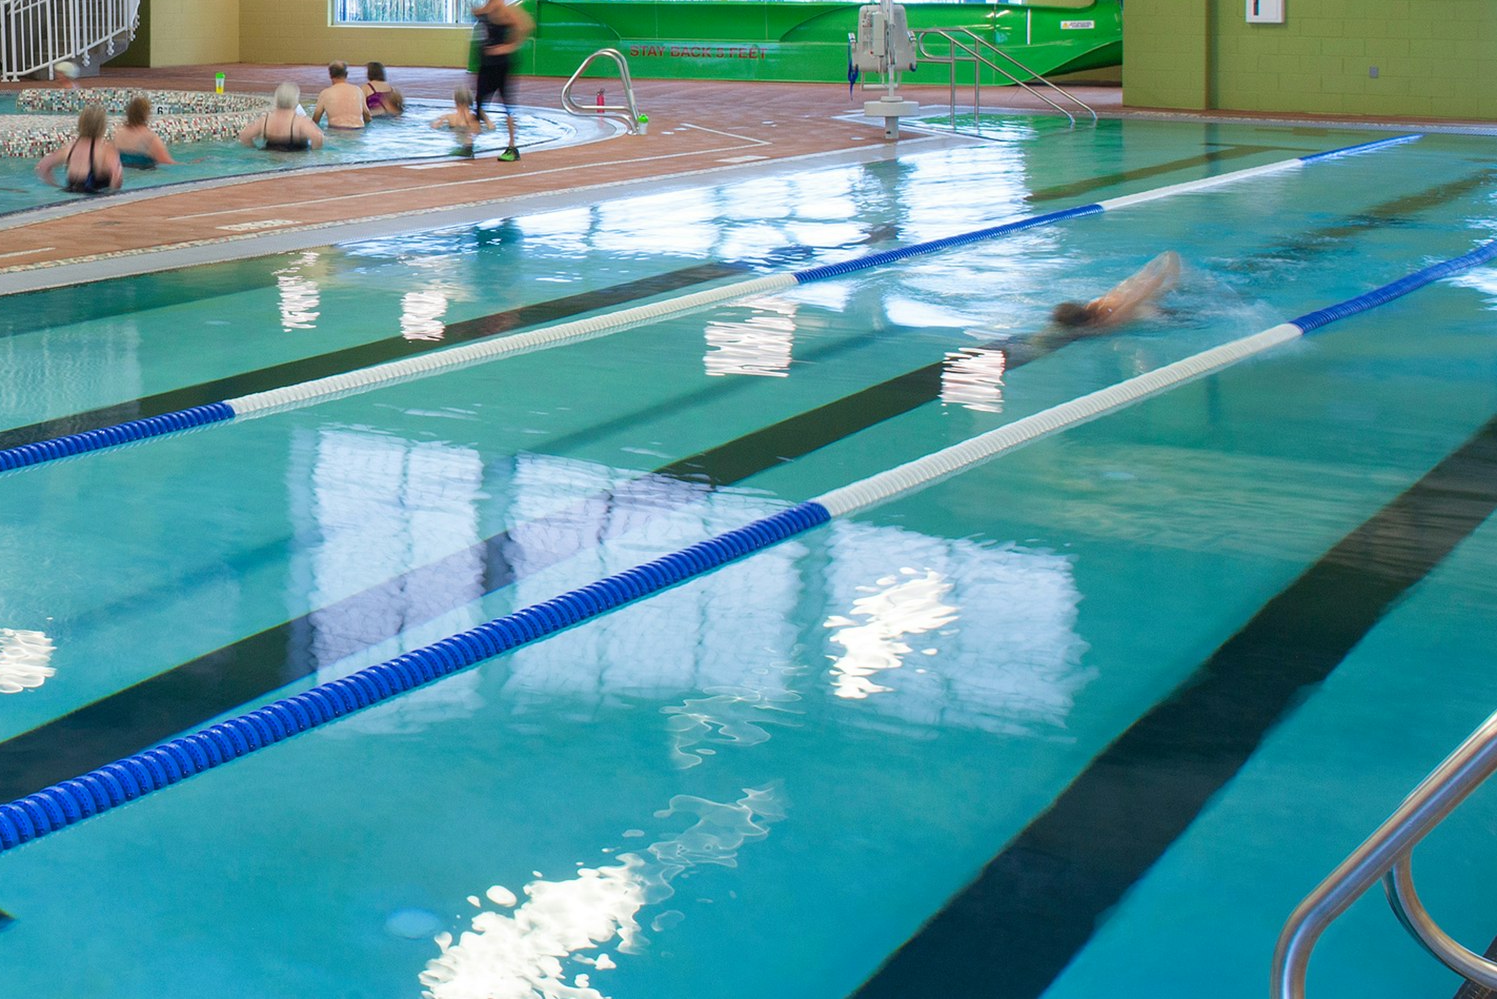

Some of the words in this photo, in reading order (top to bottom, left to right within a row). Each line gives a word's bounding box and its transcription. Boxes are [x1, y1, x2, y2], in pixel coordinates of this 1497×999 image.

[630, 45, 666, 57] STAY
[670, 46, 712, 58] BACK
[730, 47, 768, 60] FEET
